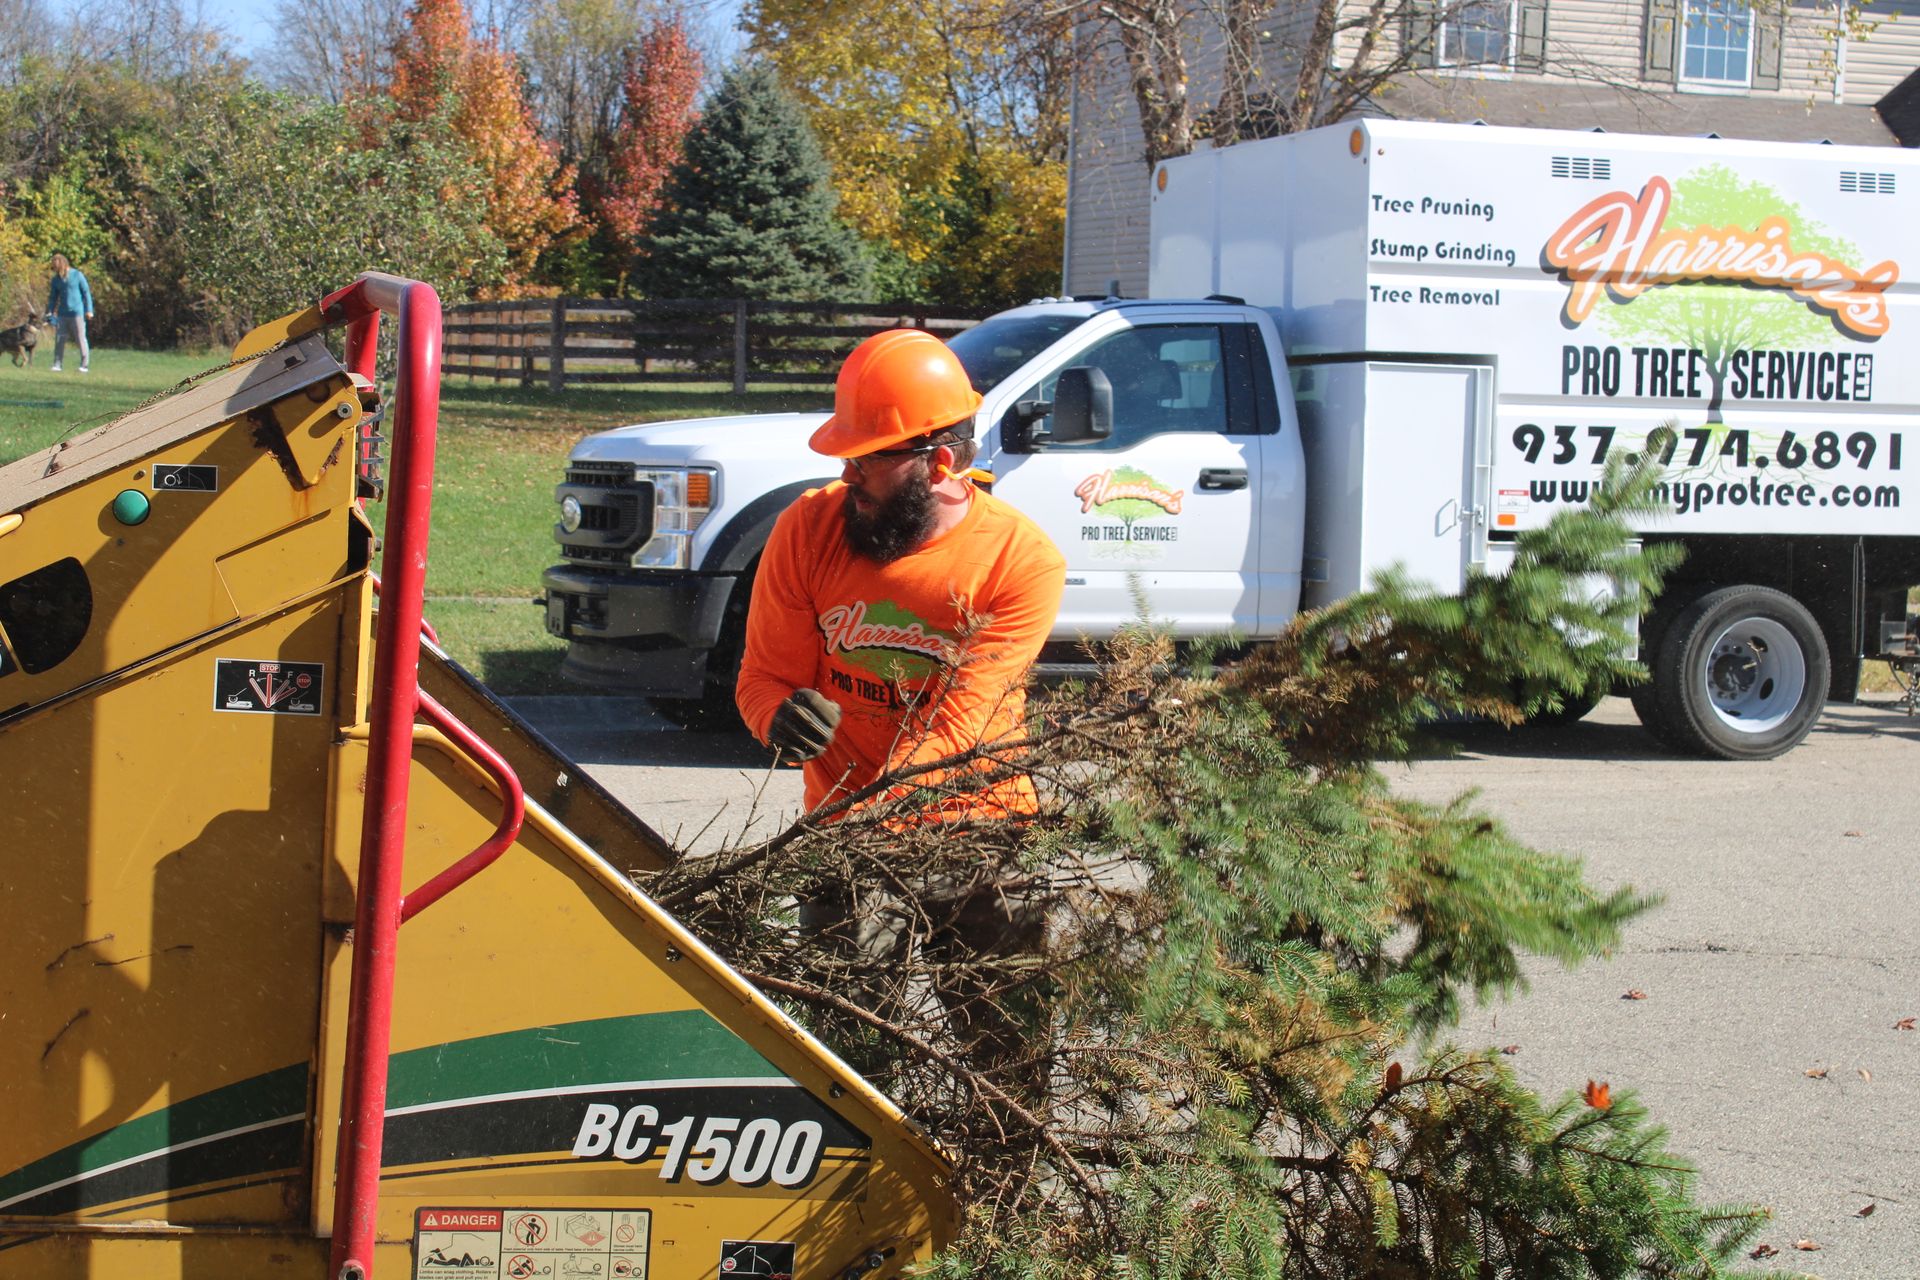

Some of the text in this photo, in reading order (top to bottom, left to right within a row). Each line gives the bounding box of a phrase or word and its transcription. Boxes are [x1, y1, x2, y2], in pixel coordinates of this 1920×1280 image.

[1372, 195, 1494, 222] Tree Pruning
[1370, 238, 1516, 267] Stump Grinding
[1547, 176, 1899, 336] Harrison's
[1370, 285, 1500, 306] Tree Removal
[1562, 345, 1850, 401] PRO TREE SERVICE
[1853, 354, 1873, 401] LLC
[1530, 476, 1900, 514] wwmyprotree.com
[1082, 526, 1100, 541] PRO
[1103, 526, 1125, 541] TREE
[1133, 526, 1170, 541] SERVICE
[249, 669, 256, 677] R
[261, 664, 279, 672] STOP
[288, 671, 294, 679] F
[831, 668, 853, 693] PRO
[856, 678, 886, 704] TREE
[441, 1214, 497, 1226] DANGER
